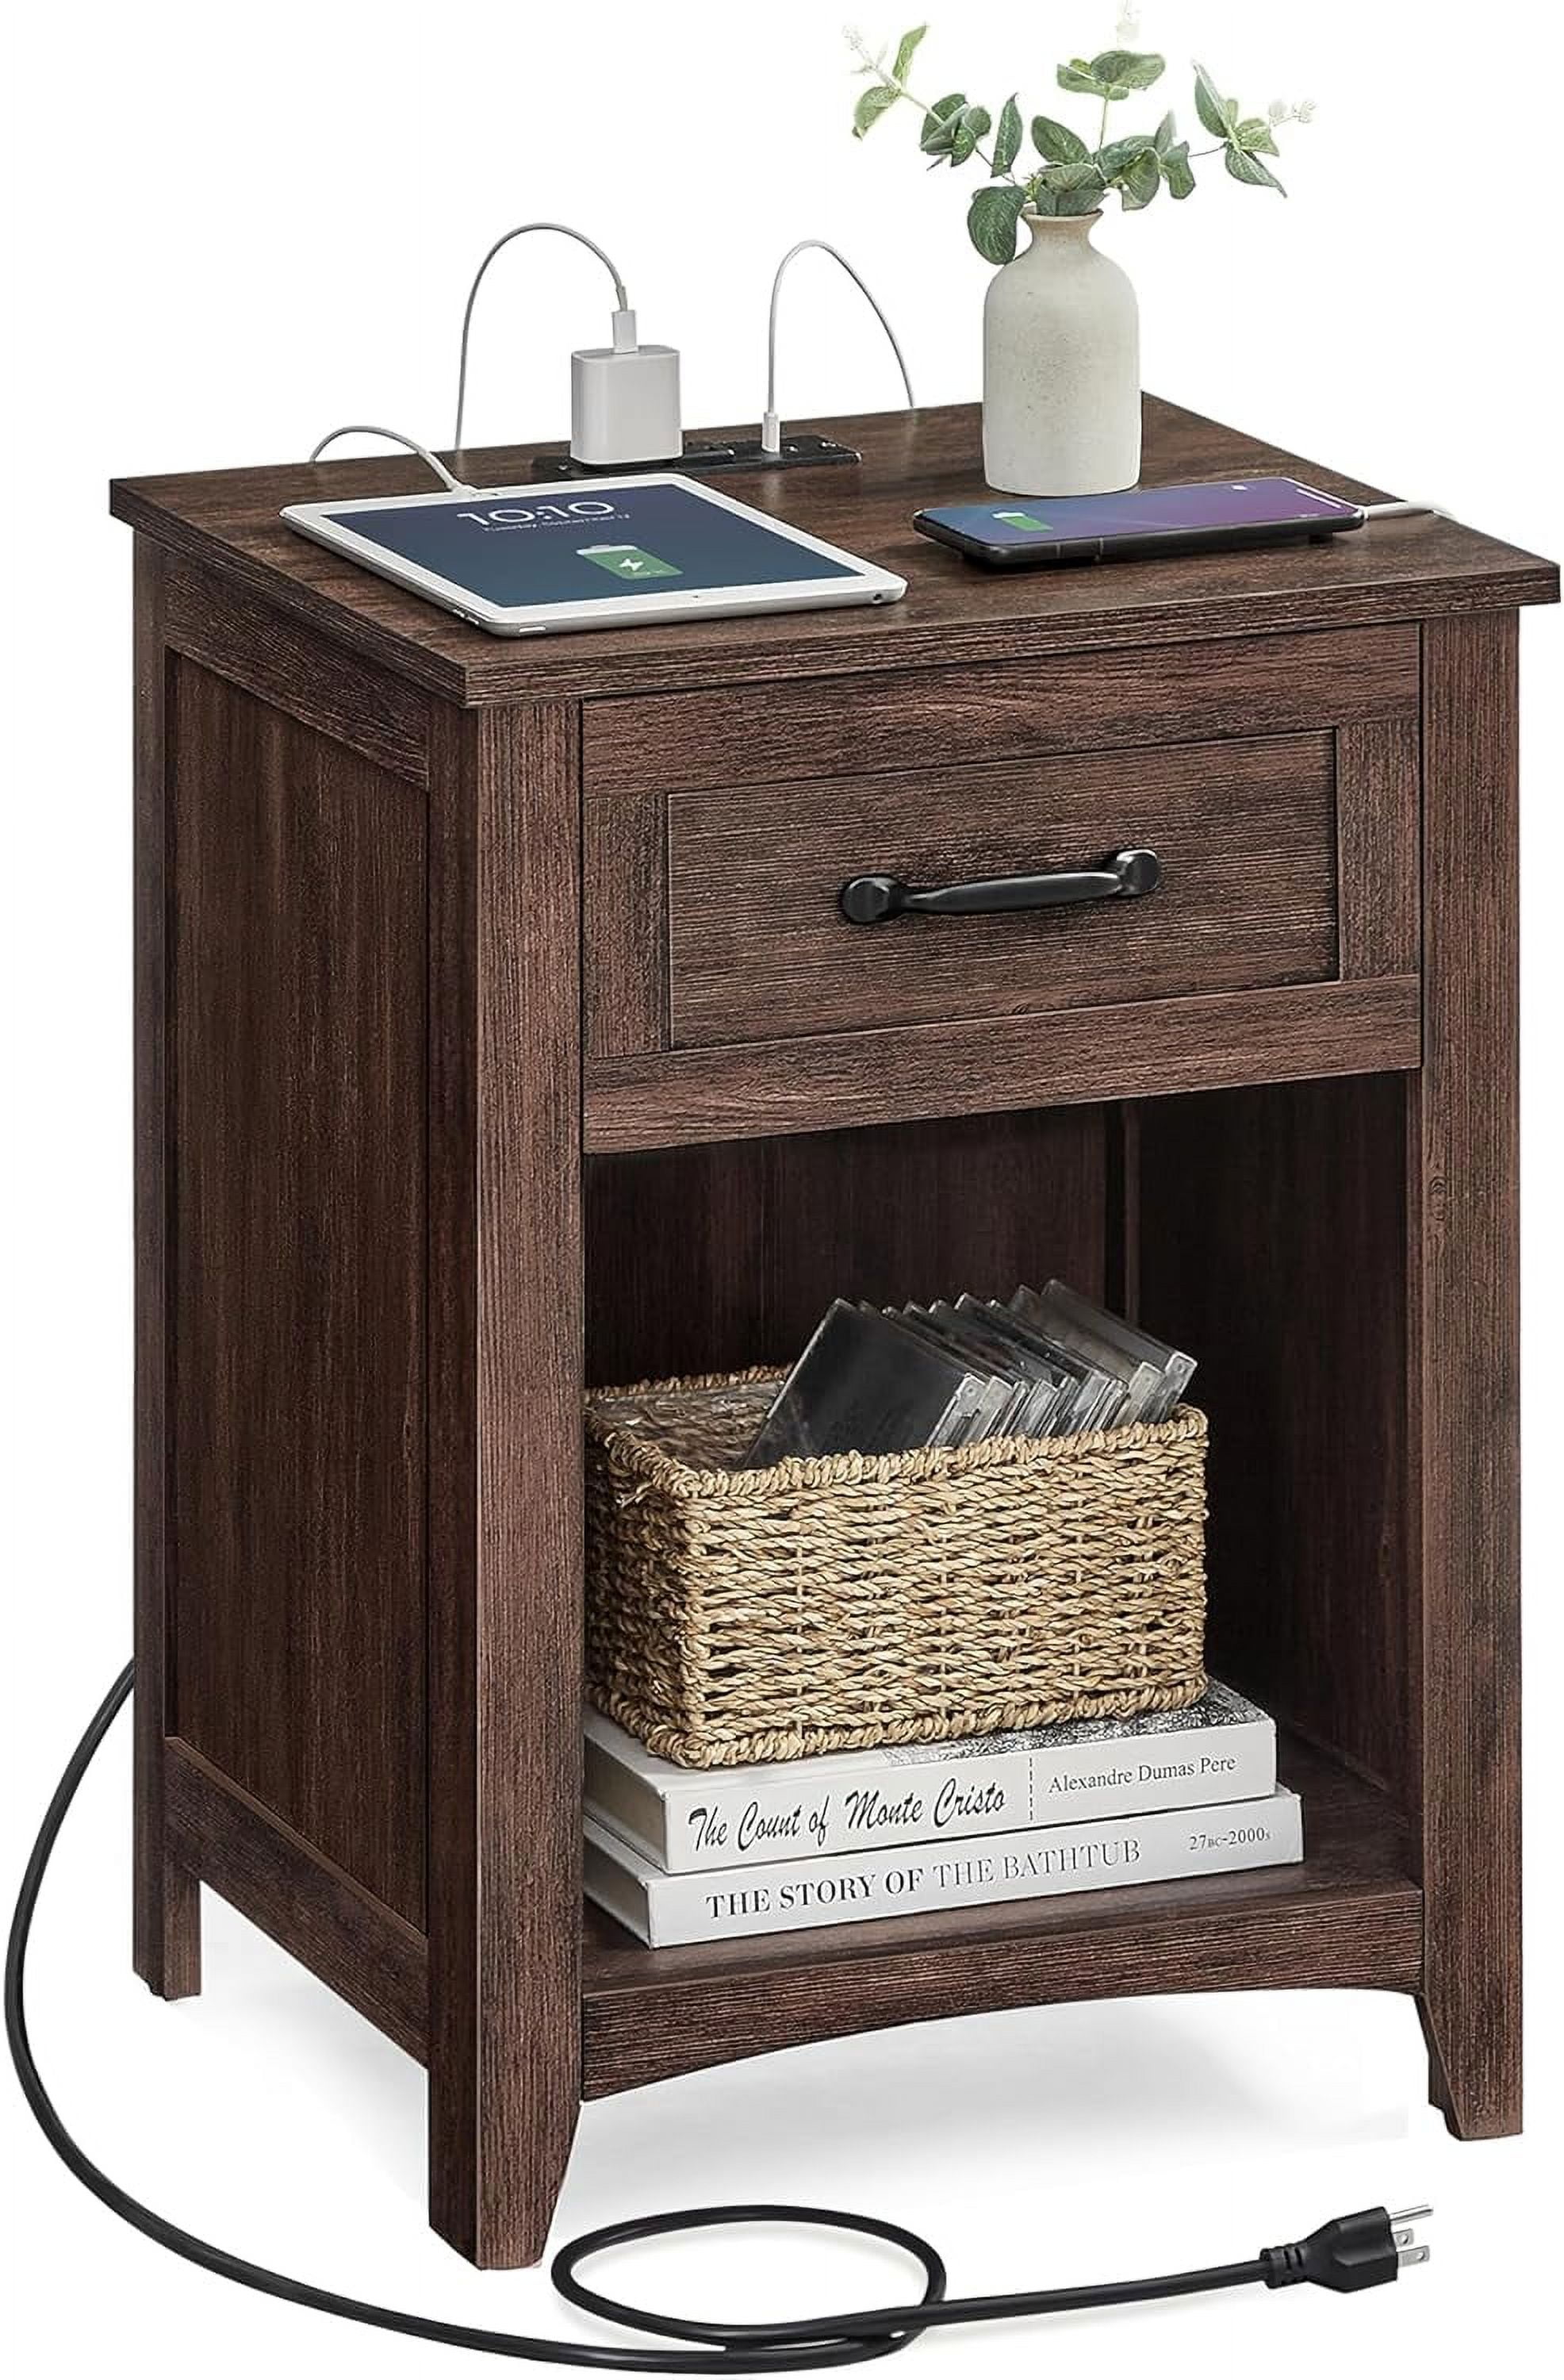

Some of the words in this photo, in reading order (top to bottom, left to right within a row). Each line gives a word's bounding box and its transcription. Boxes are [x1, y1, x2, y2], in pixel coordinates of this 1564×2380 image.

[457, 501, 615, 525] 10:10
[1048, 1768, 1133, 1793] Alexandre
[1139, 1764, 1195, 1782] Dumas
[1201, 1756, 1236, 1774] Pere
[688, 1806, 727, 1852] The
[738, 1802, 802, 1851] Count
[809, 1795, 830, 1847] of
[845, 1790, 923, 1829] Monte
[933, 1778, 1006, 1828] Cristo
[706, 1889, 770, 1918] THE
[780, 1874, 876, 1909] STORY
[885, 1868, 923, 1894] OF
[933, 1859, 994, 1888] THE
[1004, 1840, 1140, 1879] BATHTUB
